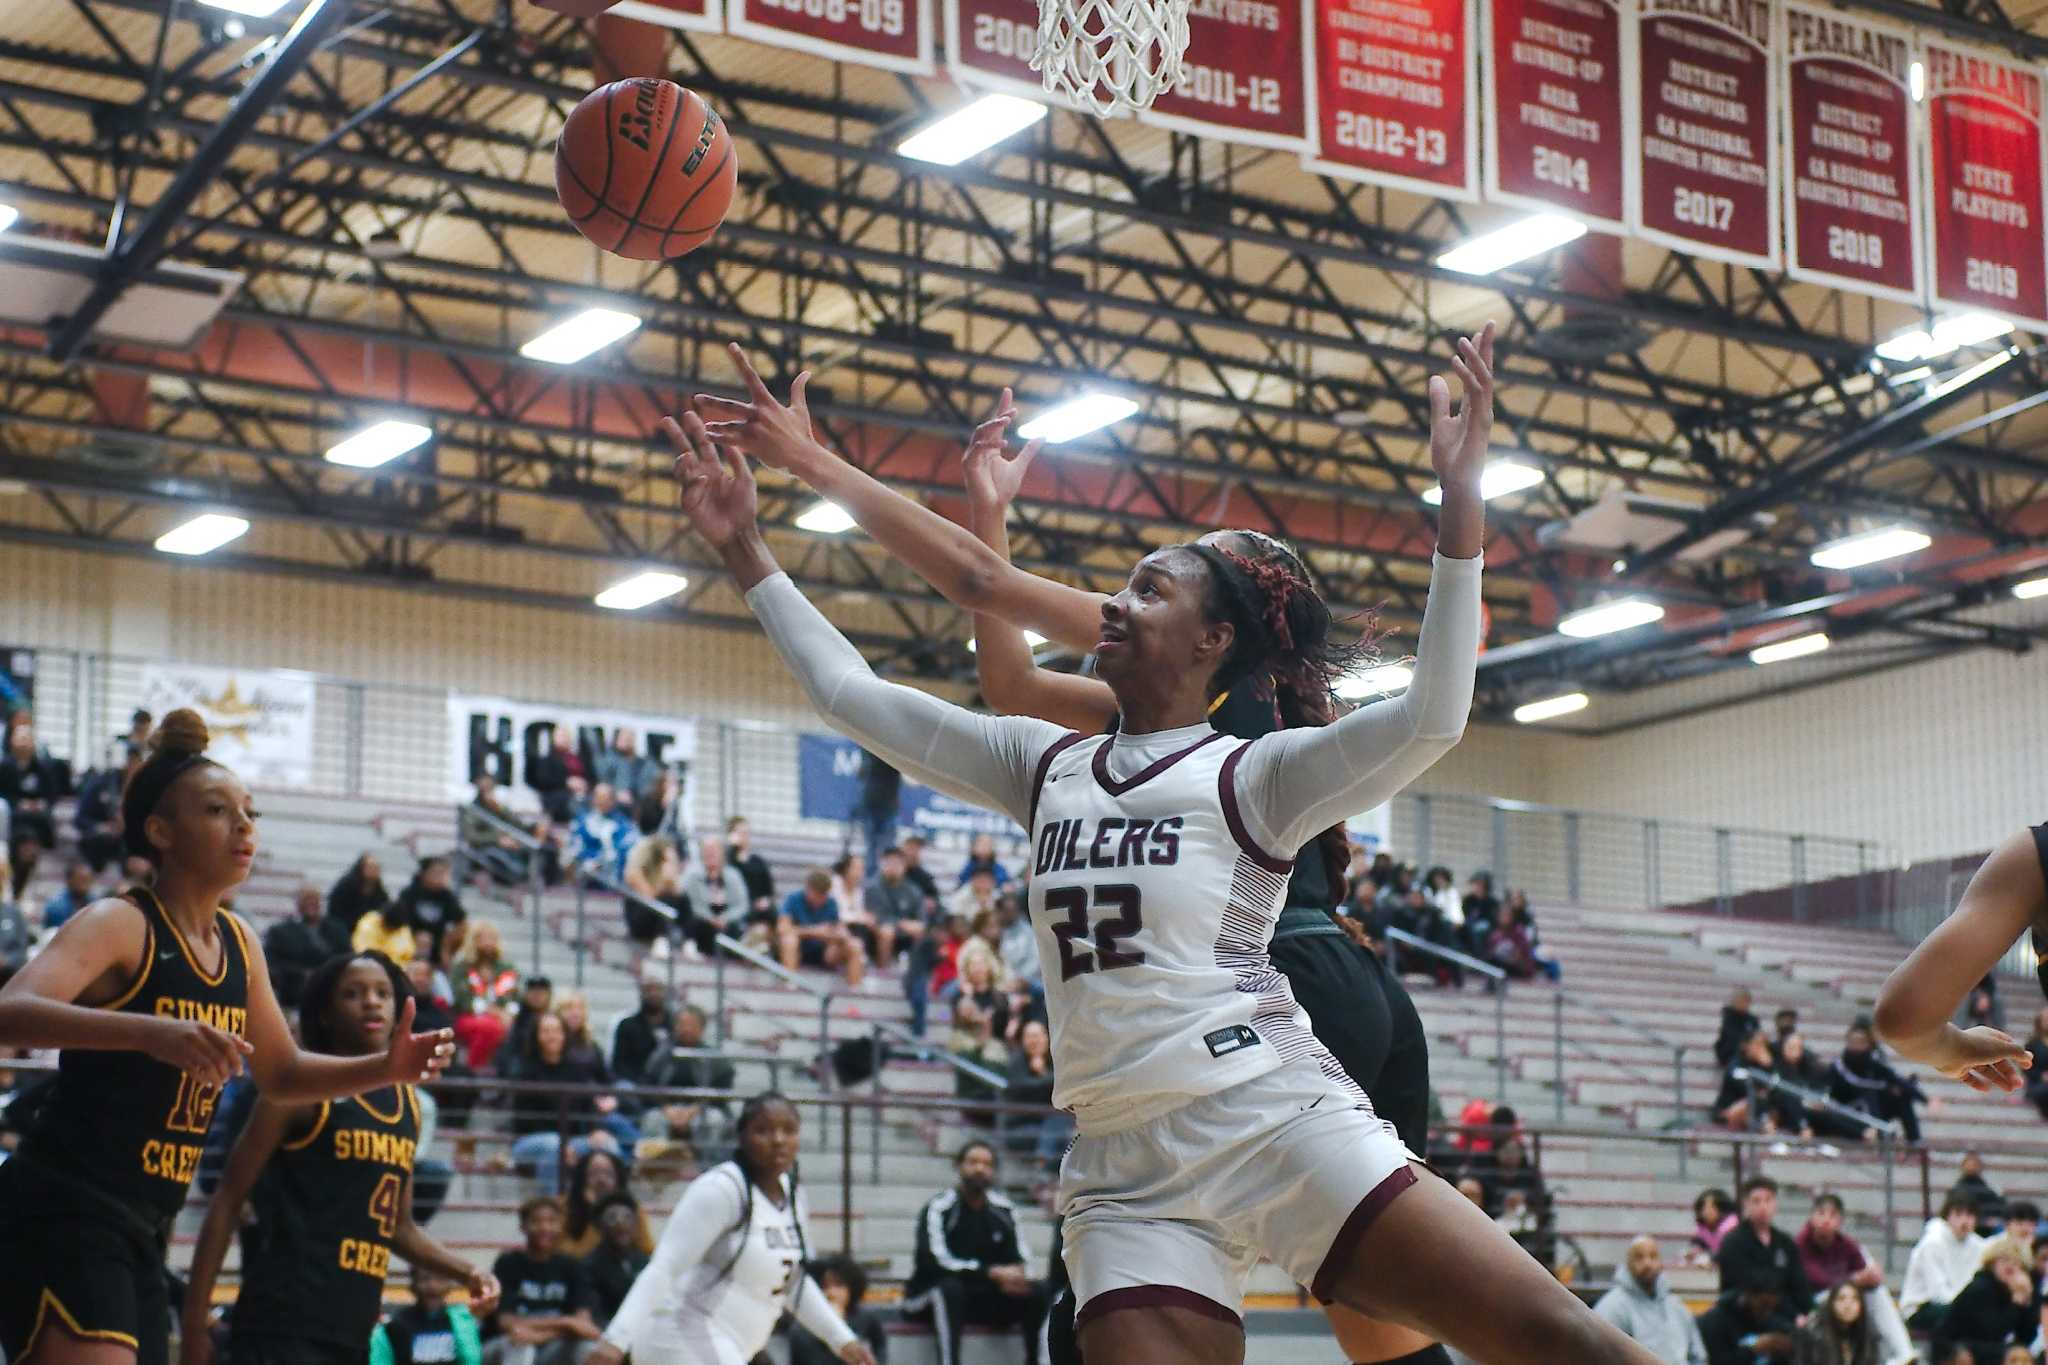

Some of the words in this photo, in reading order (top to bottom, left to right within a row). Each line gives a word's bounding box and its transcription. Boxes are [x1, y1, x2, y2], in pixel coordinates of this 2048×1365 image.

[759, 0, 904, 36] 08-09
[1190, 0, 1280, 32] LAYOFFS
[1520, 17, 1594, 54] DISTRICT
[1788, 9, 1908, 84] PEARLAND
[1177, 62, 1281, 114] 2011-12
[1338, 66, 1443, 108] CHAMPIONS
[1669, 58, 1739, 97] DISTRICT
[1926, 45, 2041, 120] PEARLAND
[1520, 102, 1600, 143] FINALISTS
[1661, 81, 1748, 124] CHAMPIONS
[1818, 102, 1883, 136] DISTRICT
[1335, 110, 1447, 166] 2012-13
[1533, 144, 1590, 193] 2014
[1962, 162, 2015, 196] STATE
[1674, 186, 1735, 231] 2017
[1951, 187, 2029, 229] PLAYOFFS
[1828, 225, 1884, 269] 2018
[1965, 257, 2020, 299] 2019
[1035, 816, 1185, 876] OILERS
[1044, 883, 1146, 983] 22
[142, 1138, 204, 1184] CRE
[368, 1172, 401, 1239] 4
[338, 1237, 391, 1279] CRE
